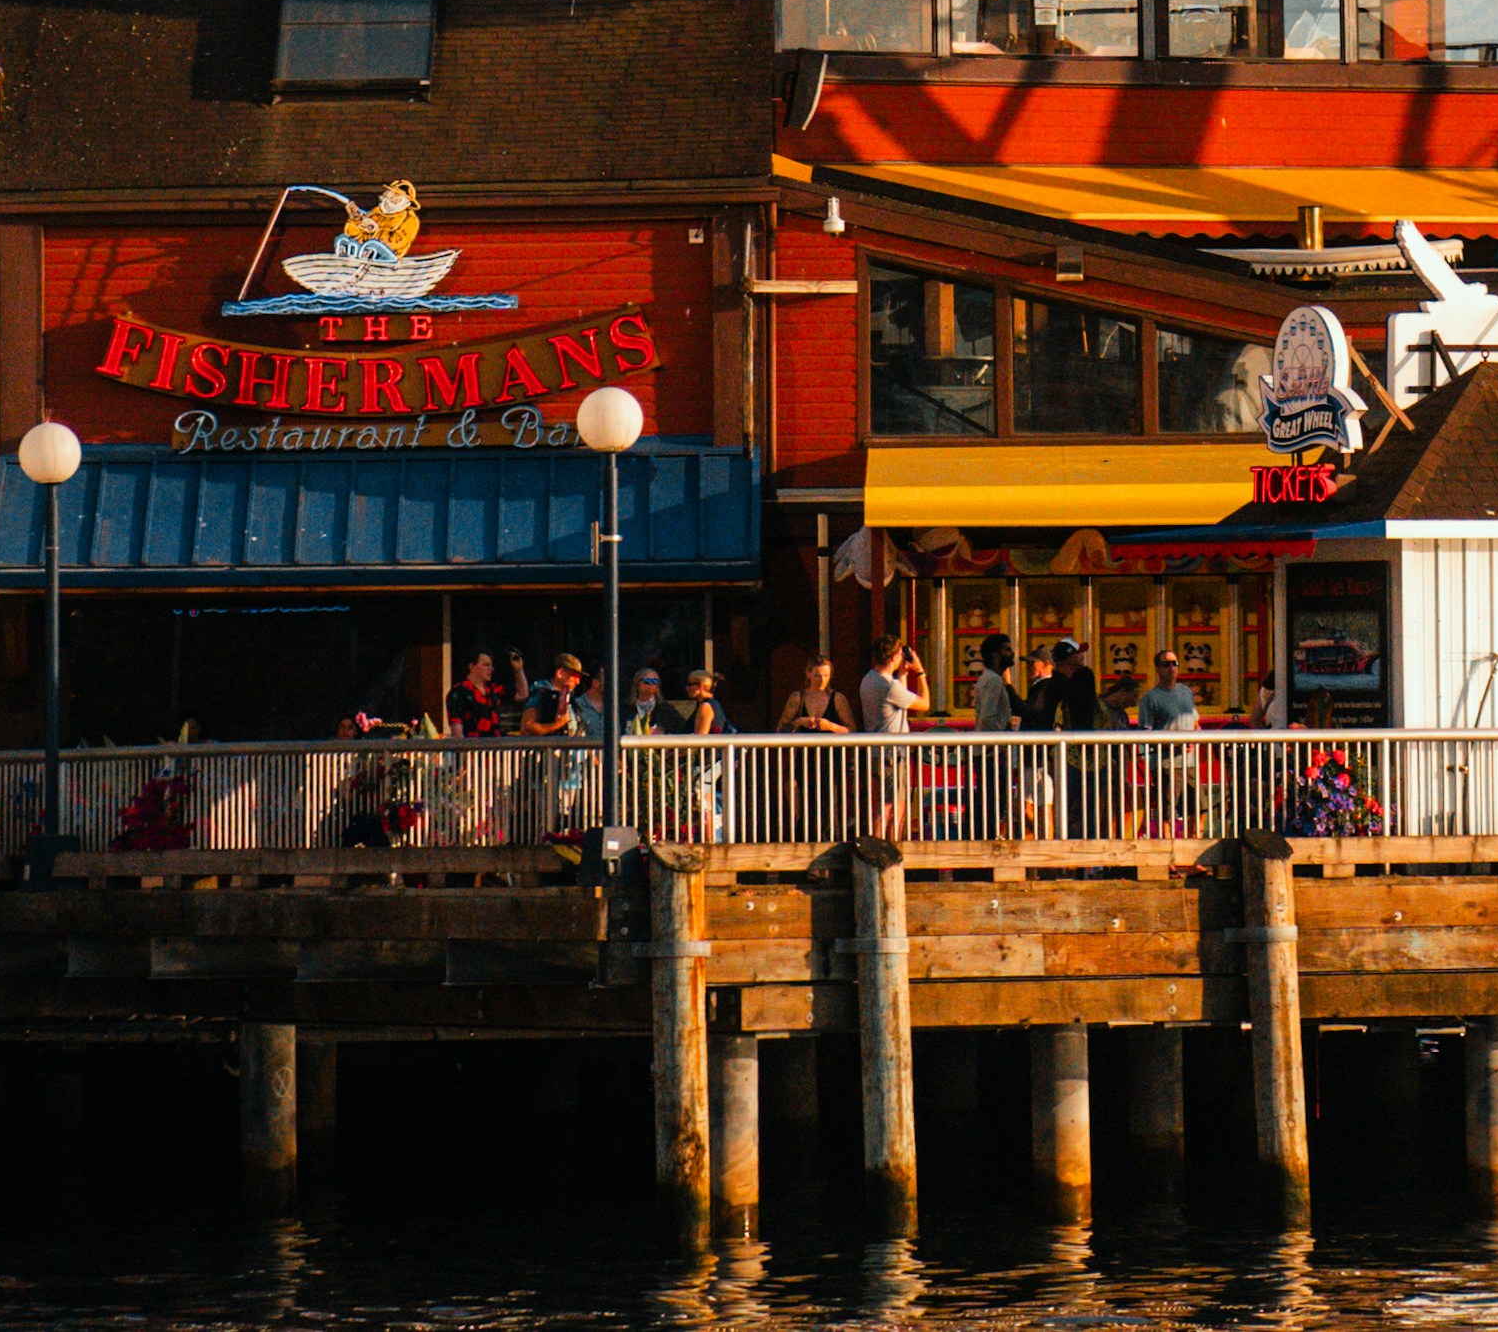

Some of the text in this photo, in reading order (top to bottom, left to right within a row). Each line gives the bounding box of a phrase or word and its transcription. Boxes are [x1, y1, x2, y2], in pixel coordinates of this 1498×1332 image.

[320, 315, 434, 341] THE
[96, 311, 657, 414] FISHERMANS
[174, 409, 433, 454] Restaurant
[447, 408, 482, 448] &
[1272, 410, 1334, 439] GREAT WHEEL
